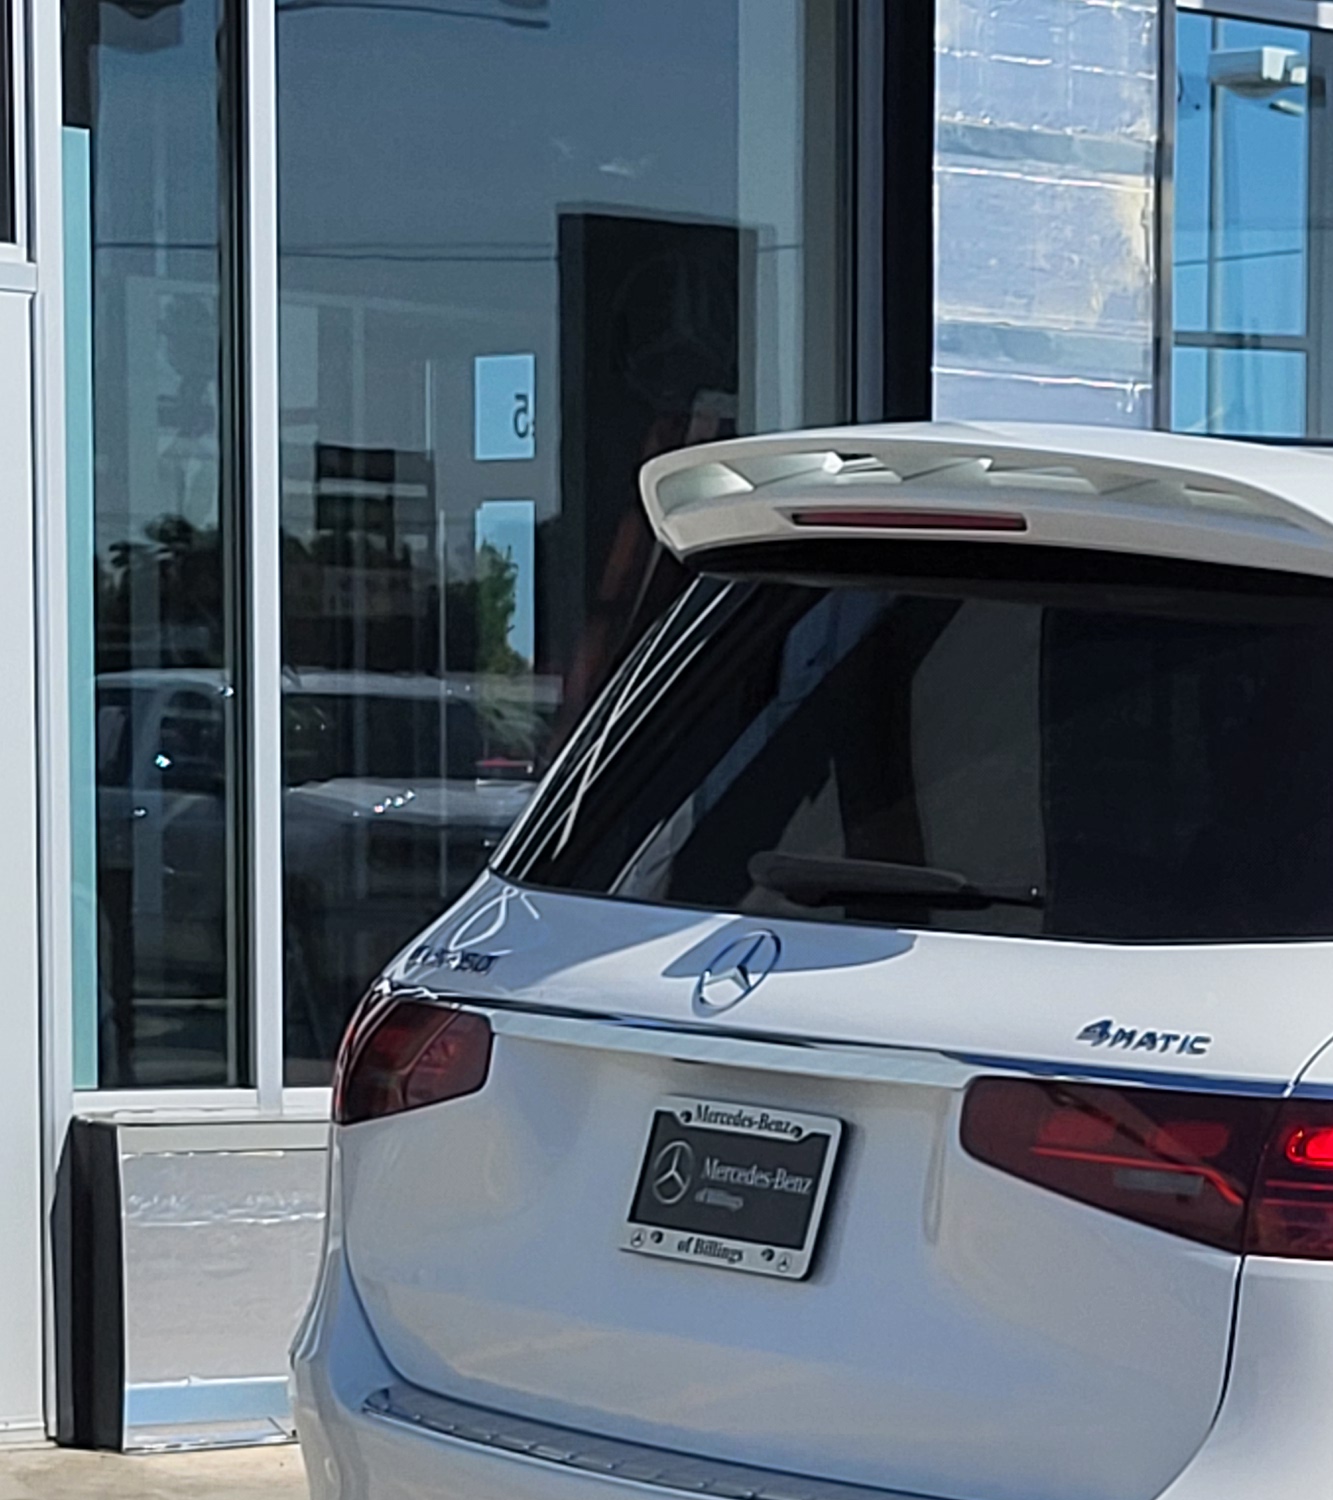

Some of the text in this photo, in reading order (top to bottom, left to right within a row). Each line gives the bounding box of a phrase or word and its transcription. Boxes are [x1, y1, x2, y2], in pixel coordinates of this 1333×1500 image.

[1076, 1019, 1212, 1055] 4MATIC
[695, 1104, 791, 1134] Mercedes-Benz
[700, 1157, 814, 1195] Mercedes-Benz
[677, 1236, 744, 1264] of Billings
